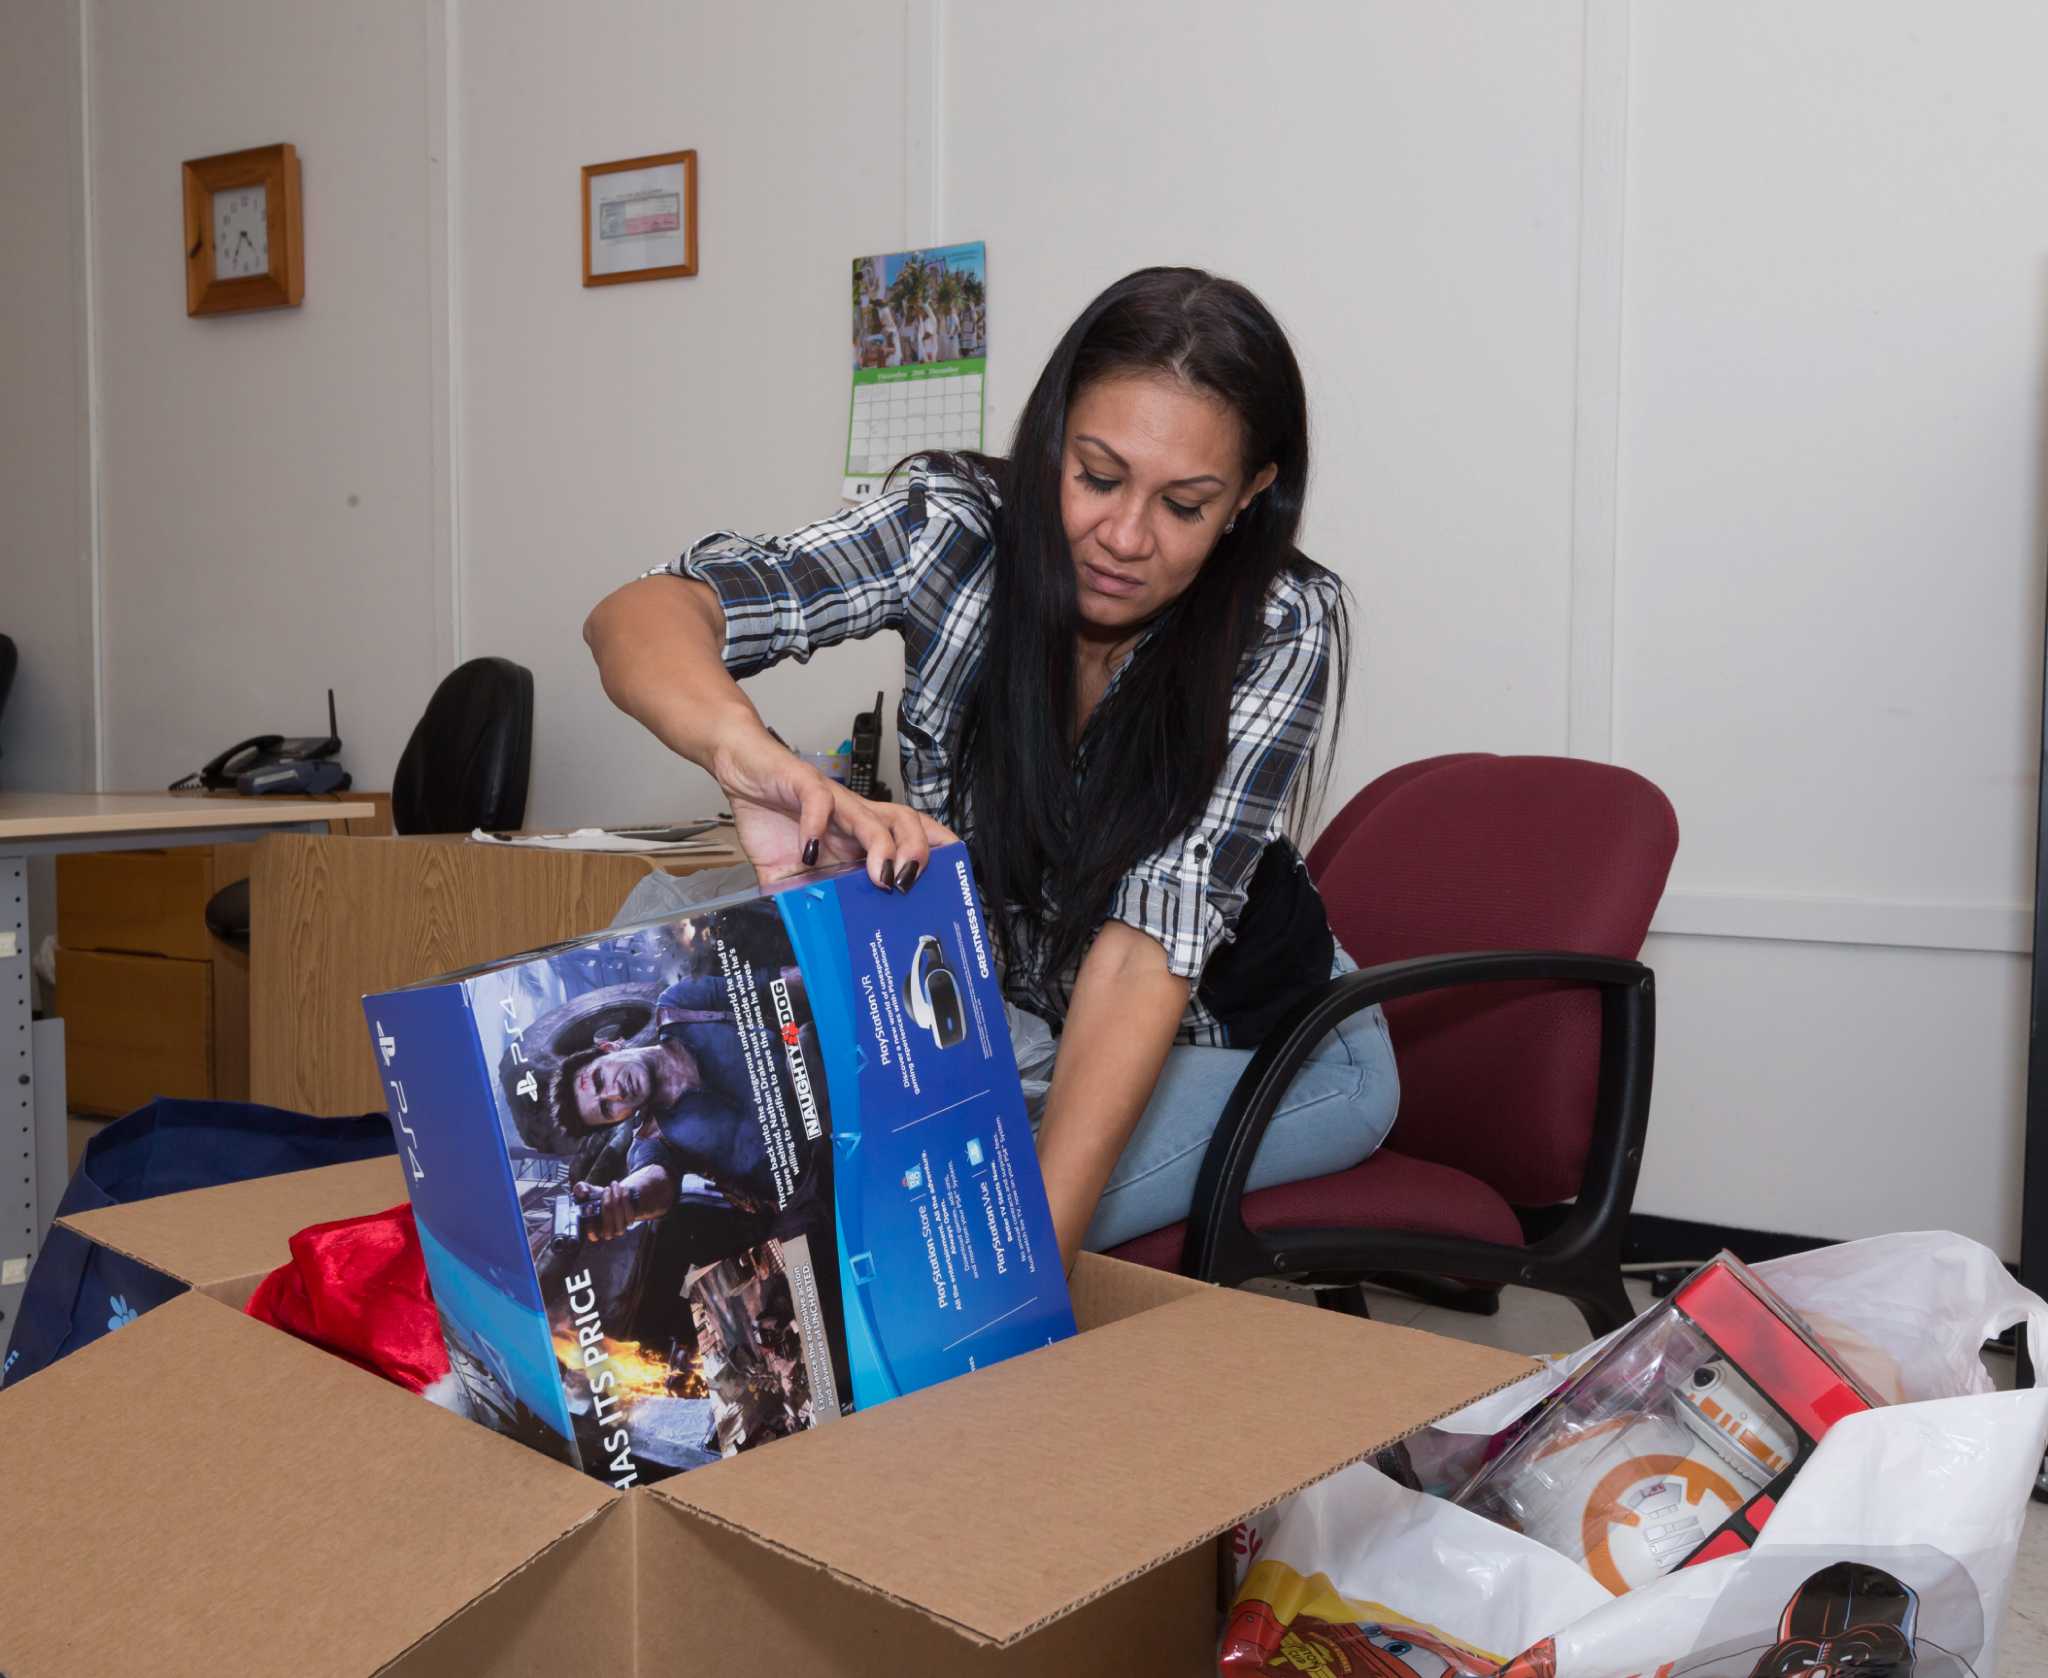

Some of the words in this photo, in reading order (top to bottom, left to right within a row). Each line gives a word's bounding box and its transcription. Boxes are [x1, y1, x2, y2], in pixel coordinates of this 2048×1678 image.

[956, 861, 973, 906] AWAITS
[714, 939, 725, 951] to
[729, 948, 739, 969] he's
[967, 908, 989, 978] GREATNESS
[718, 952, 731, 977] tried
[744, 960, 755, 990] loves.
[870, 942, 886, 989] unexpected
[726, 978, 735, 991] he
[734, 970, 746, 995] what
[750, 991, 758, 1004] he
[861, 975, 873, 993] VR
[881, 991, 889, 999] of
[741, 997, 754, 1030] decide
[754, 1005, 764, 1028] ones
[774, 982, 793, 1024] DOG
[884, 1001, 894, 1025] world
[891, 994, 899, 1012] with
[499, 995, 527, 1064] PS4
[728, 992, 749, 1050] underworld
[868, 993, 890, 1065] PlayStation
[749, 1032, 760, 1057] must
[760, 1031, 768, 1048] the
[896, 1013, 911, 1061] experiences
[757, 1059, 768, 1089] Drake
[765, 1049, 775, 1072] save
[898, 1053, 910, 1087] Discover
[745, 1052, 762, 1104] dangerous
[770, 1074, 778, 1085] to
[788, 1046, 819, 1136] NAUGHTY
[908, 1063, 920, 1094] gaming
[758, 1105, 766, 1122] the
[765, 1091, 778, 1128] Nathan
[774, 1086, 788, 1128] sacrifice
[390, 1081, 424, 1181] PS4
[762, 1124, 772, 1145] into
[784, 1129, 791, 1141] to
[766, 1145, 778, 1170] back
[773, 1129, 787, 1166] behind,
[787, 1141, 799, 1175] willing
[783, 1168, 794, 1195] leave
[921, 1149, 935, 1194] adventure.
[772, 1170, 787, 1210] Thrown
[980, 1182, 991, 1206] Vue
[919, 1206, 931, 1237] Store
[941, 1199, 949, 1224] Open.
[938, 1221, 955, 1282] entertainment.
[946, 1225, 956, 1254] Always
[986, 1205, 1006, 1273] PlayStation
[793, 1266, 805, 1295] action
[927, 1238, 947, 1308] PlayStation
[567, 1268, 608, 1367] PRICE
[799, 1296, 813, 1340] explosive
[806, 1342, 815, 1358] the
[814, 1330, 824, 1340] of
[817, 1341, 830, 1386] adventure
[590, 1371, 623, 1426] ITS
[811, 1357, 825, 1411] Experience
[825, 1388, 834, 1406] and
[603, 1429, 638, 1489] HAS
